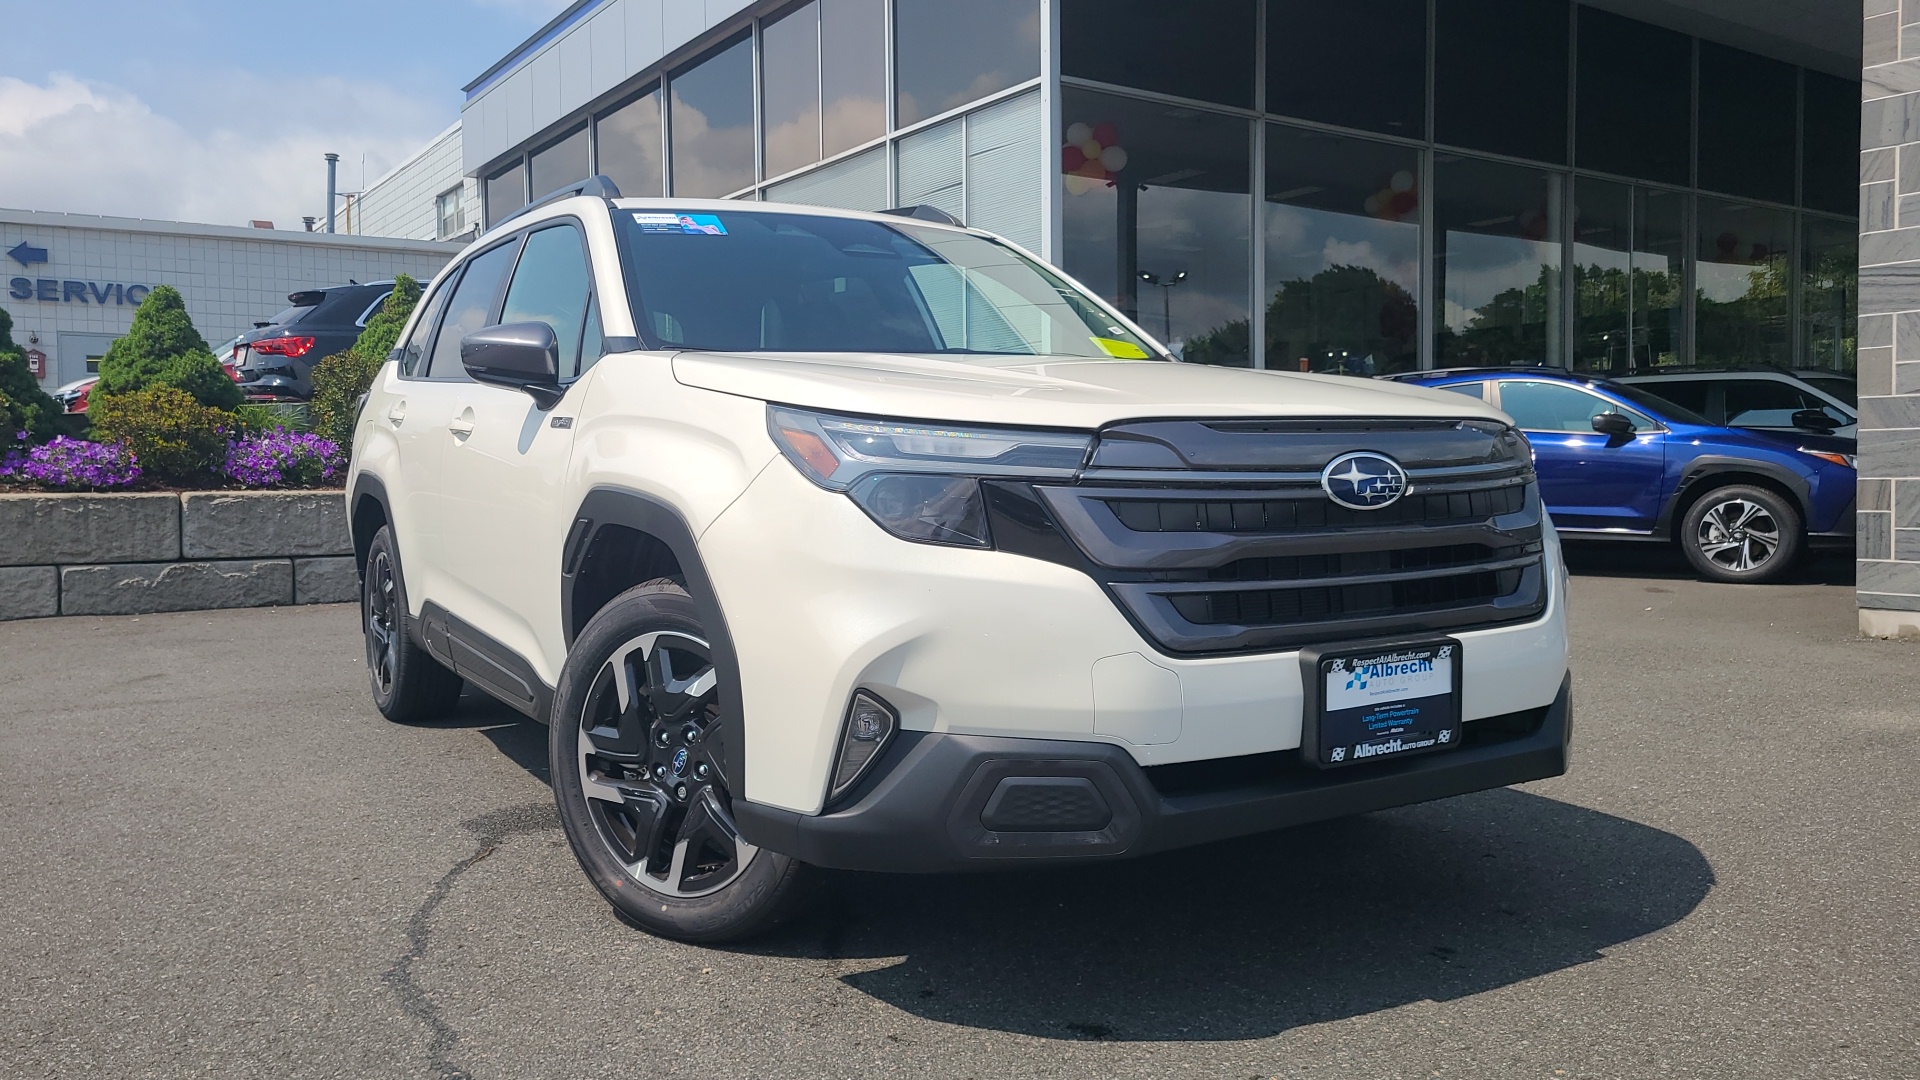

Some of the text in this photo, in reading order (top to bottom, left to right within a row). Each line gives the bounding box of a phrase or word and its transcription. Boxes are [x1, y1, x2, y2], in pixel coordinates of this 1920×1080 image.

[9, 277, 160, 306] SERVIC
[1352, 652, 1431, 667] RespectAtAlbrecht.com
[1370, 660, 1433, 678] Albrecht
[1369, 673, 1434, 688] AUTO GROUP
[1362, 708, 1419, 722] Long-Term Powertrain
[1368, 718, 1413, 731] Limited Warranty
[1354, 739, 1435, 759] Albrecht AUTO GROUP
